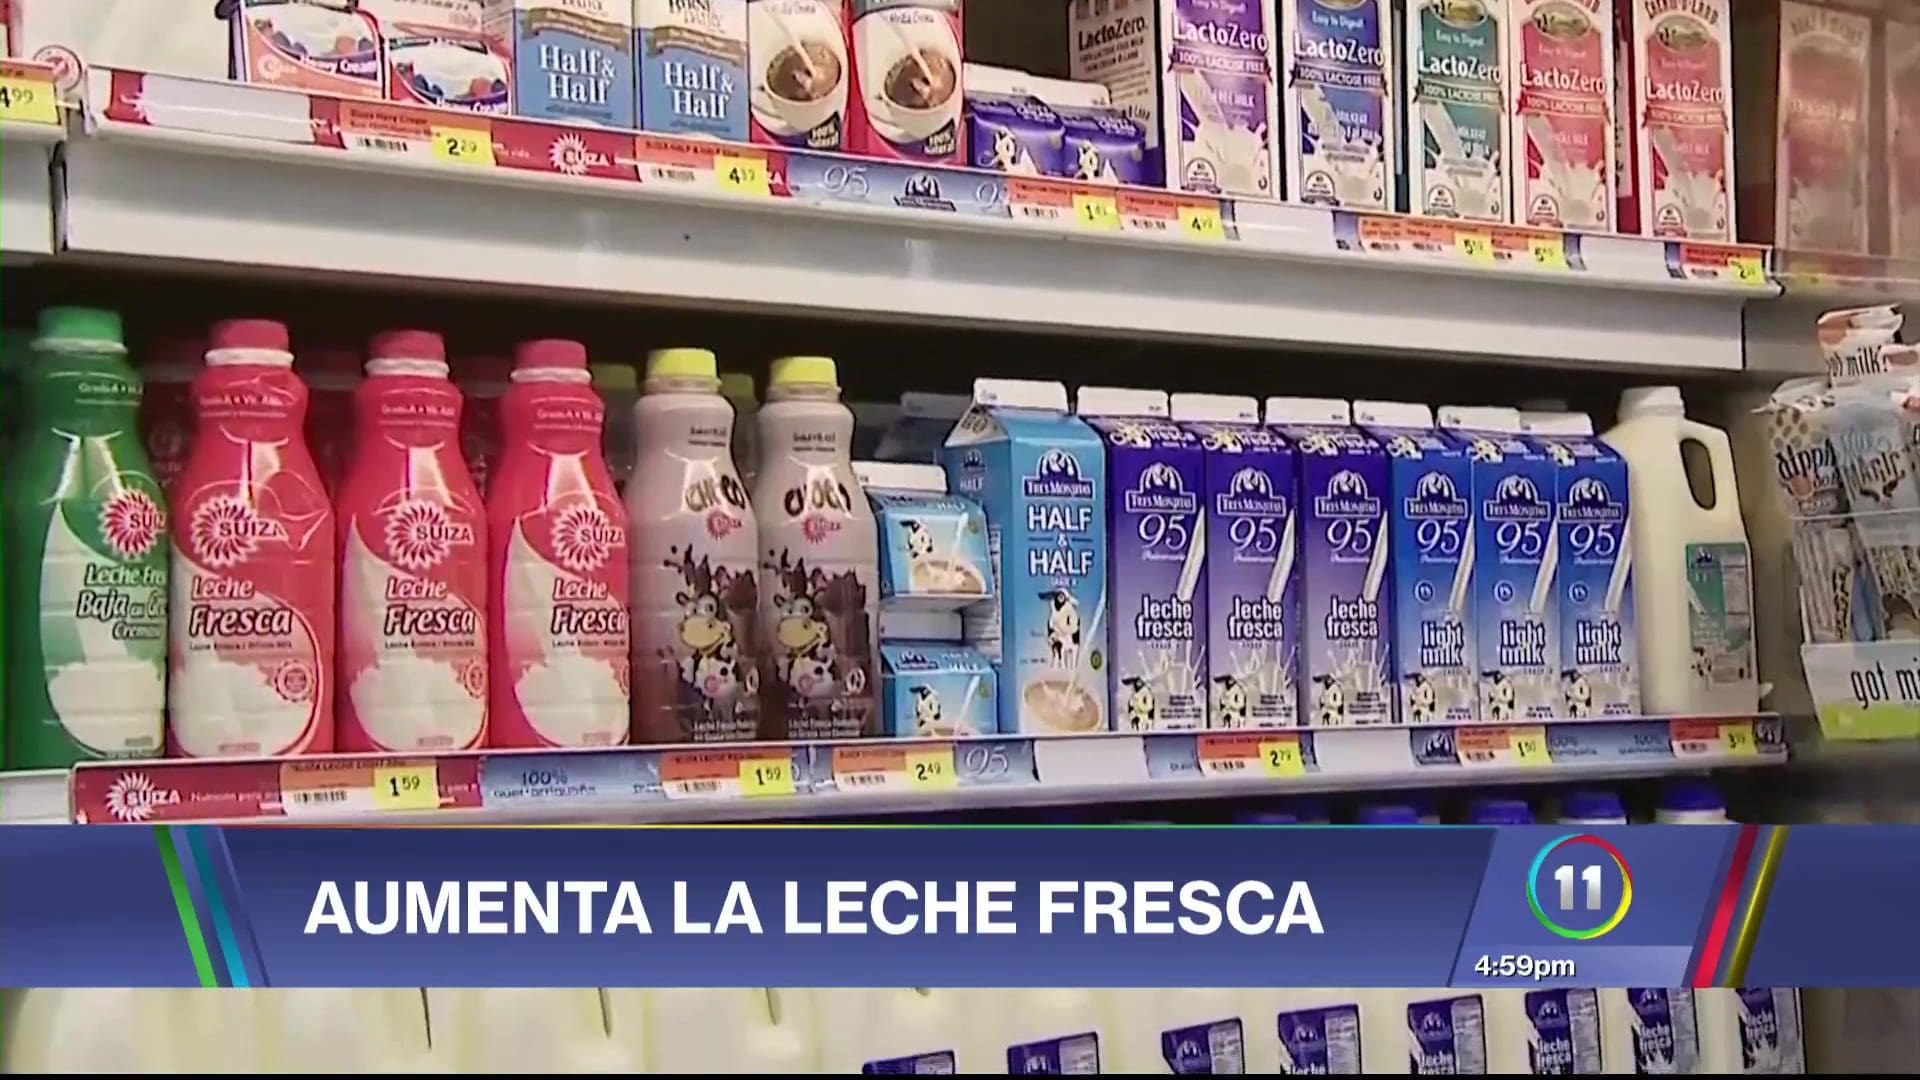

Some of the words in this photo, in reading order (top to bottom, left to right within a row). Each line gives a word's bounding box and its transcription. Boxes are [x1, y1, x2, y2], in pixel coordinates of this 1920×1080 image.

[1078, 16, 1145, 51] LactoZero
[1173, 17, 1269, 51] LactoZero
[539, 43, 603, 77] Half
[601, 58, 617, 79] &
[1294, 31, 1385, 67] LactoZero
[663, 60, 724, 91] Half
[721, 73, 736, 94] &
[1418, 49, 1501, 83] LactoZero
[1520, 62, 1606, 95] LactoZero
[549, 73, 611, 105] Half
[1646, 77, 1724, 104] LactoZero
[672, 89, 729, 120] Half
[823, 166, 870, 199] 95
[218, 515, 289, 540] SUIZA
[415, 518, 474, 542] SUIZA
[1028, 504, 1092, 532] HALF
[1138, 513, 1188, 551] 95
[579, 525, 625, 546] SUIZA
[1057, 531, 1068, 549] &
[1229, 516, 1278, 553] 95
[1326, 517, 1372, 553] 95
[1417, 519, 1461, 554] 95
[1496, 521, 1543, 556] 95
[1569, 523, 1616, 557] 95
[84, 563, 140, 587] Leche
[1029, 549, 1095, 577] HALF
[191, 575, 255, 601] Leche
[386, 577, 448, 601] Leche
[553, 577, 608, 601] Leche
[76, 589, 130, 622] Baja
[383, 603, 478, 636] Fresca
[550, 603, 628, 635] Fresca
[1143, 594, 1193, 619] leche
[1233, 594, 1283, 620] leche
[1331, 595, 1378, 619] leche
[188, 604, 294, 638] Fresca
[1136, 612, 1194, 640] fresca
[1227, 614, 1284, 640] fresca
[1325, 614, 1379, 640] fresca
[1420, 620, 1465, 648] light
[1500, 620, 1547, 648] light
[1576, 619, 1622, 647] light
[1420, 645, 1464, 667] milk
[1499, 645, 1546, 667] milk
[1575, 645, 1622, 666] milk
[1851, 661, 1889, 710] got
[965, 746, 1009, 775] 95
[520, 767, 568, 786] 100%
[755, 766, 782, 787] 159
[126, 788, 182, 806] SUIZA
